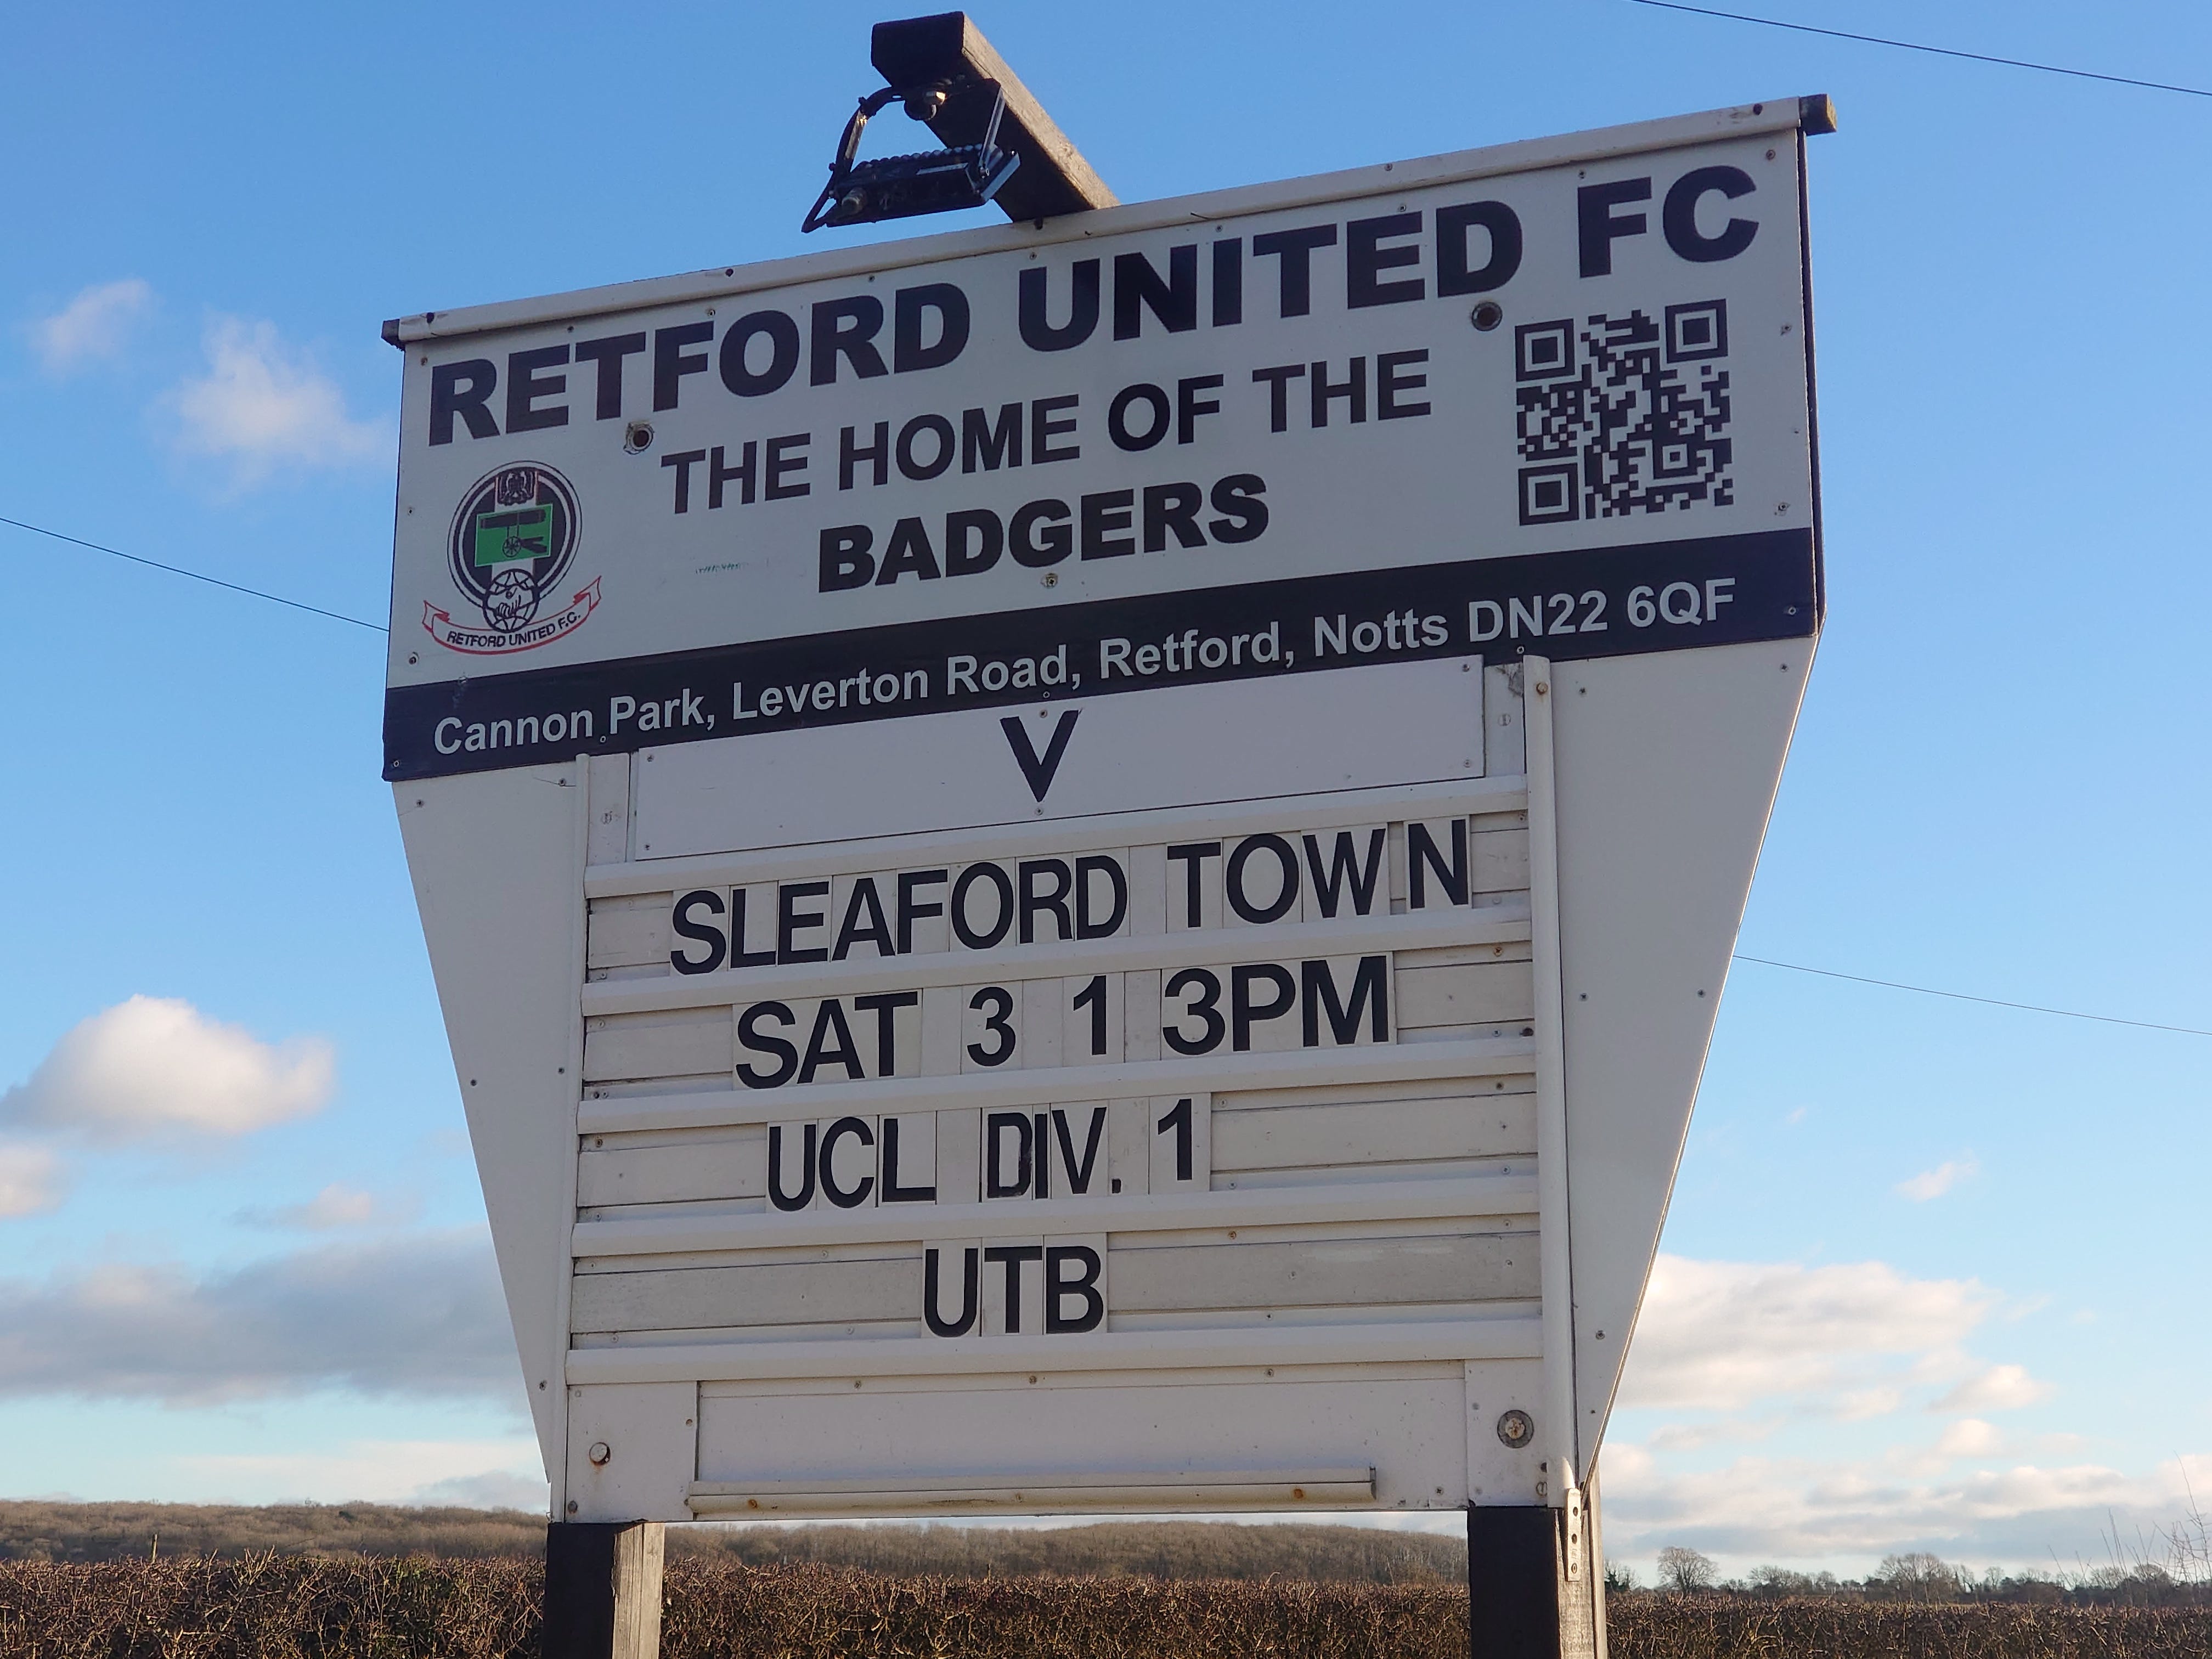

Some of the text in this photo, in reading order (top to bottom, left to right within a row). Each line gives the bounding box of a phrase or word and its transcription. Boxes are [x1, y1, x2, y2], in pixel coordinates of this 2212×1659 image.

[429, 166, 1759, 447] RETFORD UNITED FC
[661, 348, 1431, 514] THE HOME OF THE
[819, 473, 1269, 592] BADGERS
[434, 578, 1736, 754] Cannon Park, Leverton Road, Retford, Notts DN22 6QF
[447, 631, 505, 647] RETFORD
[509, 623, 555, 646] UNITED
[1000, 710, 1079, 802] V
[670, 819, 1468, 975] SLEAFORD TOWN
[736, 956, 1389, 1089] SAT 3 1 3PM
[768, 1098, 1192, 1211] UCL DIV. 1
[924, 1245, 1104, 1338] UTB
